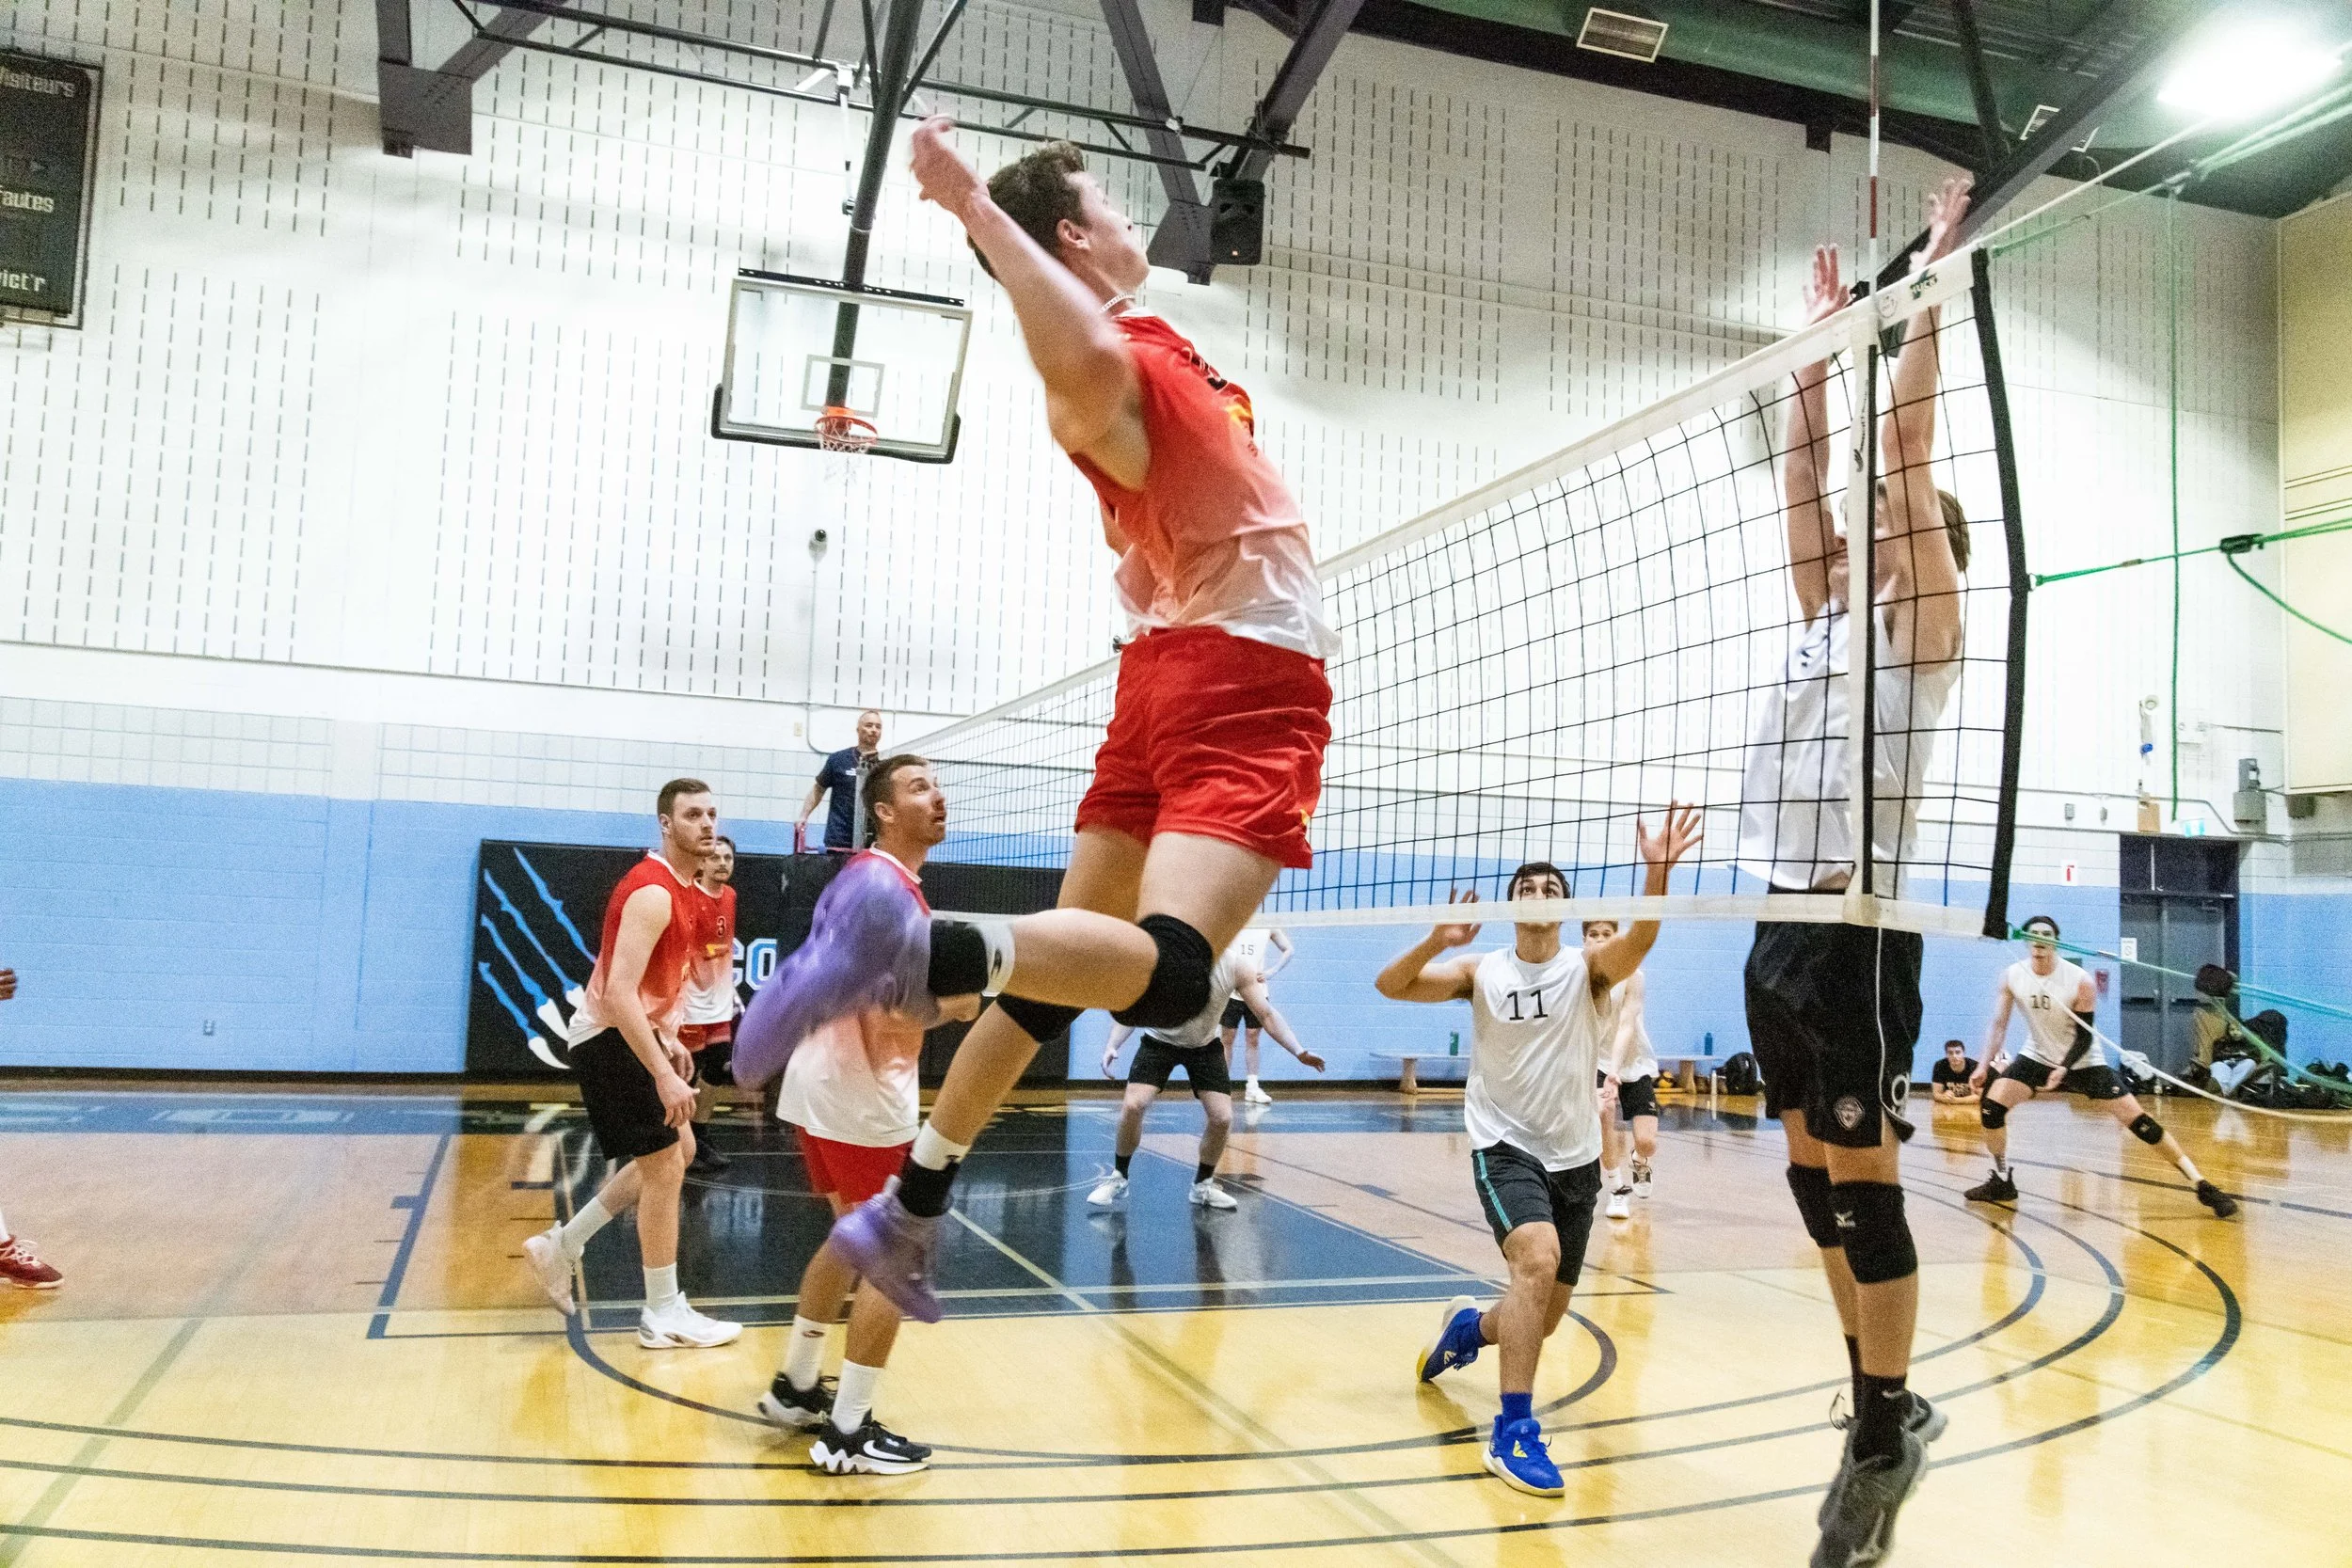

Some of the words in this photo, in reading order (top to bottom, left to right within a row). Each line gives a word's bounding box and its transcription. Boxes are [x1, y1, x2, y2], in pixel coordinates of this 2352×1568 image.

[0, 185, 55, 213] autes
[717, 916, 726, 937] 3
[1241, 943, 1254, 956] 15
[1506, 989, 1549, 1021] 11
